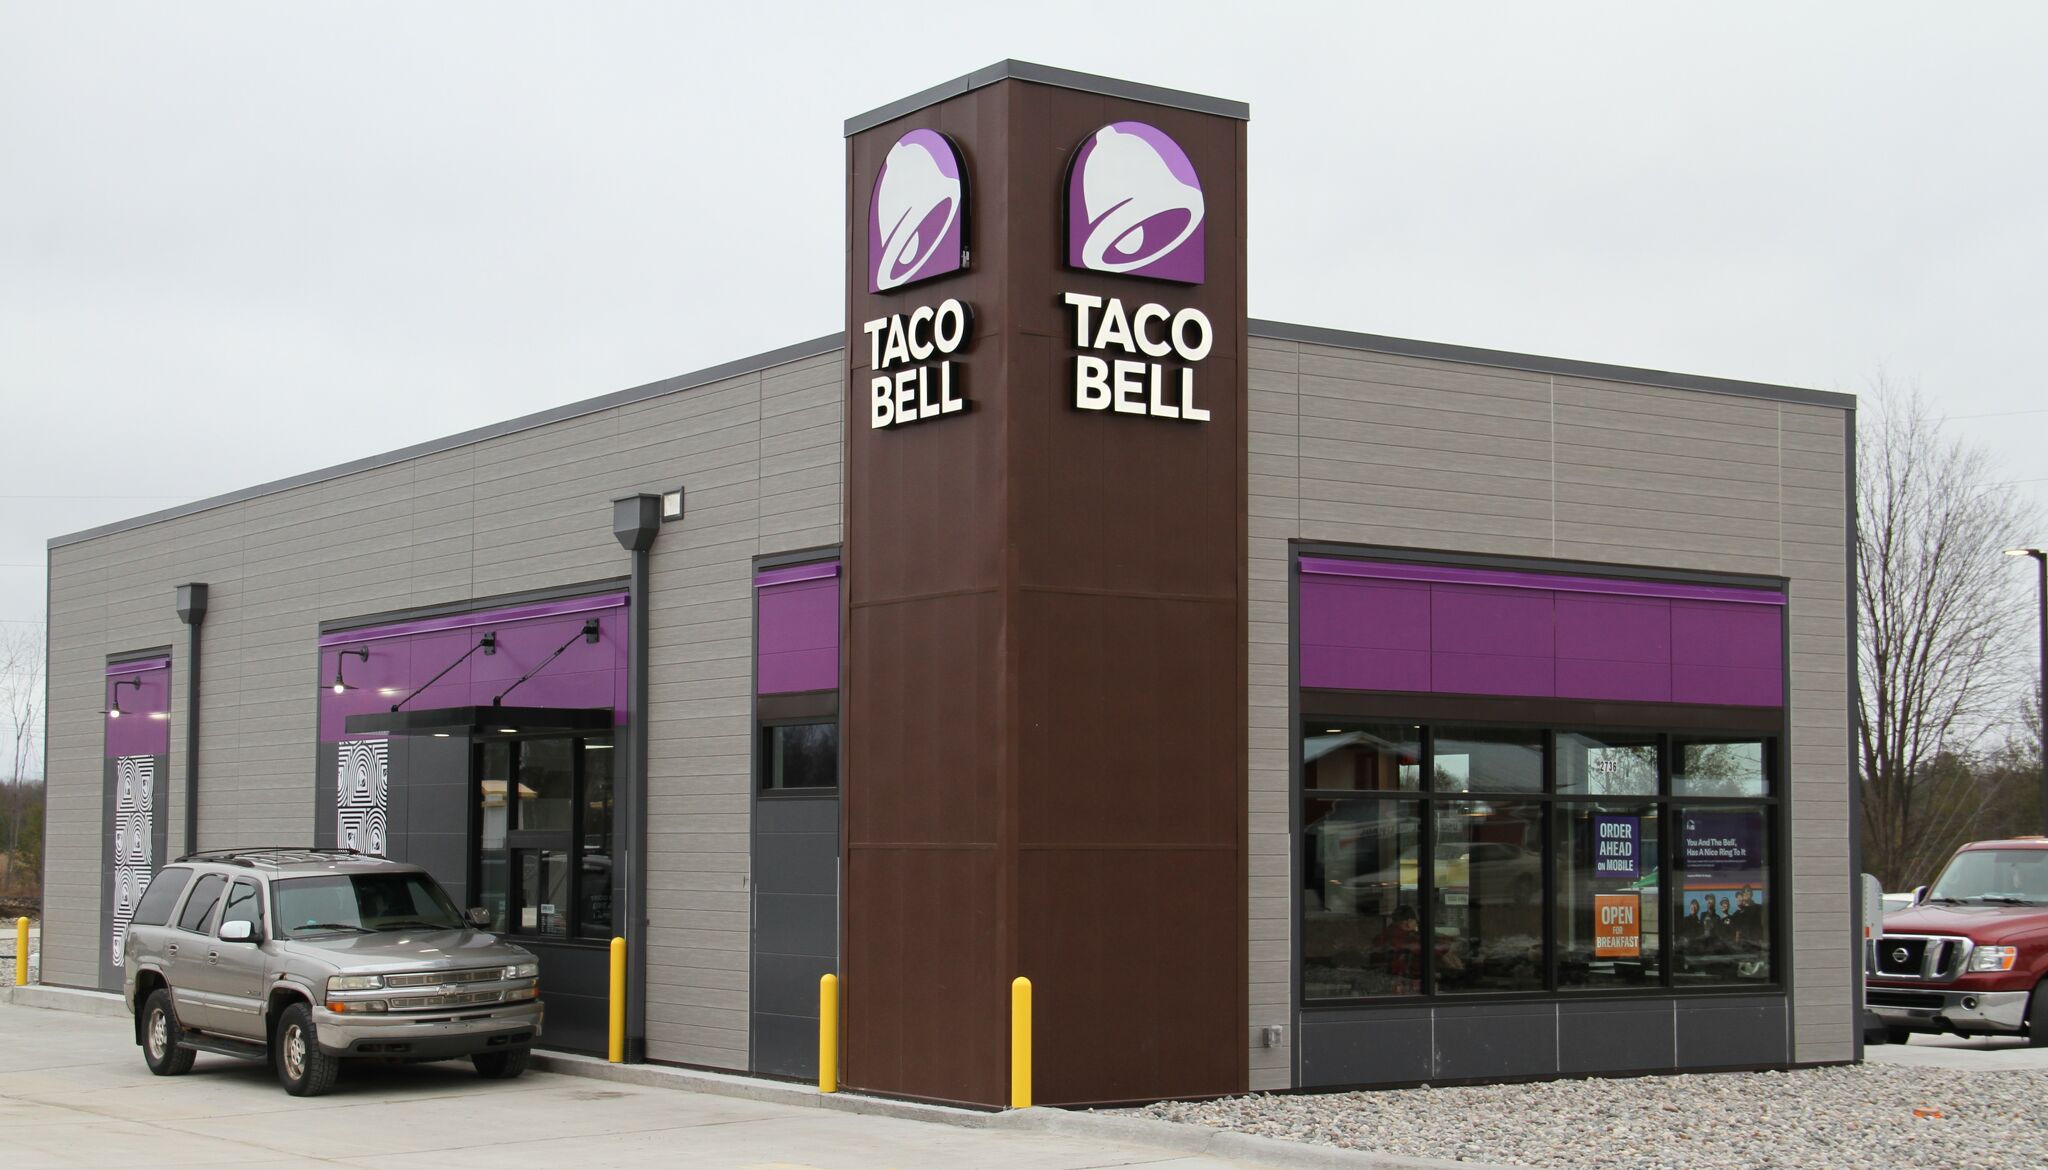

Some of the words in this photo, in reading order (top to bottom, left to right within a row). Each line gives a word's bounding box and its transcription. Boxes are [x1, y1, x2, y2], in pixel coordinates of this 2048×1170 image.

[1065, 292, 1213, 361] TACO
[864, 298, 964, 371] TACO
[872, 360, 963, 429] BELL
[1077, 355, 1210, 422] BELL
[1600, 761, 1617, 772] 2736
[1600, 822, 1632, 839] ORDER
[1600, 841, 1632, 856] AHEAD
[1686, 838, 1697, 846] You
[1698, 838, 1710, 846] And
[1711, 838, 1722, 846] The
[1686, 848, 1698, 856] Has
[1699, 848, 1704, 856] A
[1704, 848, 1718, 856] Nice
[1719, 848, 1733, 858] Ring
[1733, 848, 1740, 856] To
[1741, 848, 1747, 856] It
[1606, 859, 1633, 871] MOBILE
[1601, 906, 1632, 925] OPEN
[1612, 926, 1623, 935] FOR
[1596, 936, 1639, 948] BREAKFAST
